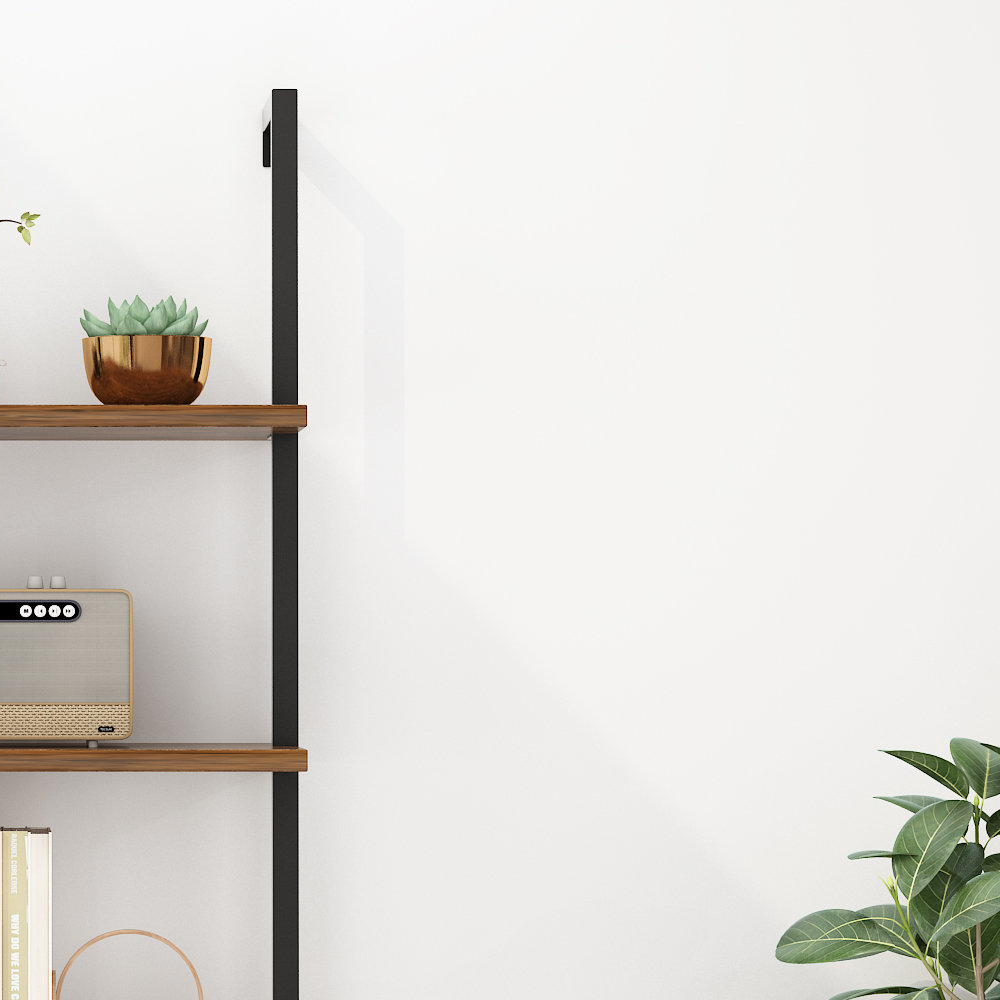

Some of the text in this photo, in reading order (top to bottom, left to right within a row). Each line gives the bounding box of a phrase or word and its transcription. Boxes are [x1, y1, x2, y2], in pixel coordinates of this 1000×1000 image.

[10, 913, 20, 935] WHY
[10, 937, 20, 950] DO
[10, 952, 20, 967] WE
[10, 969, 20, 992] LOVE
